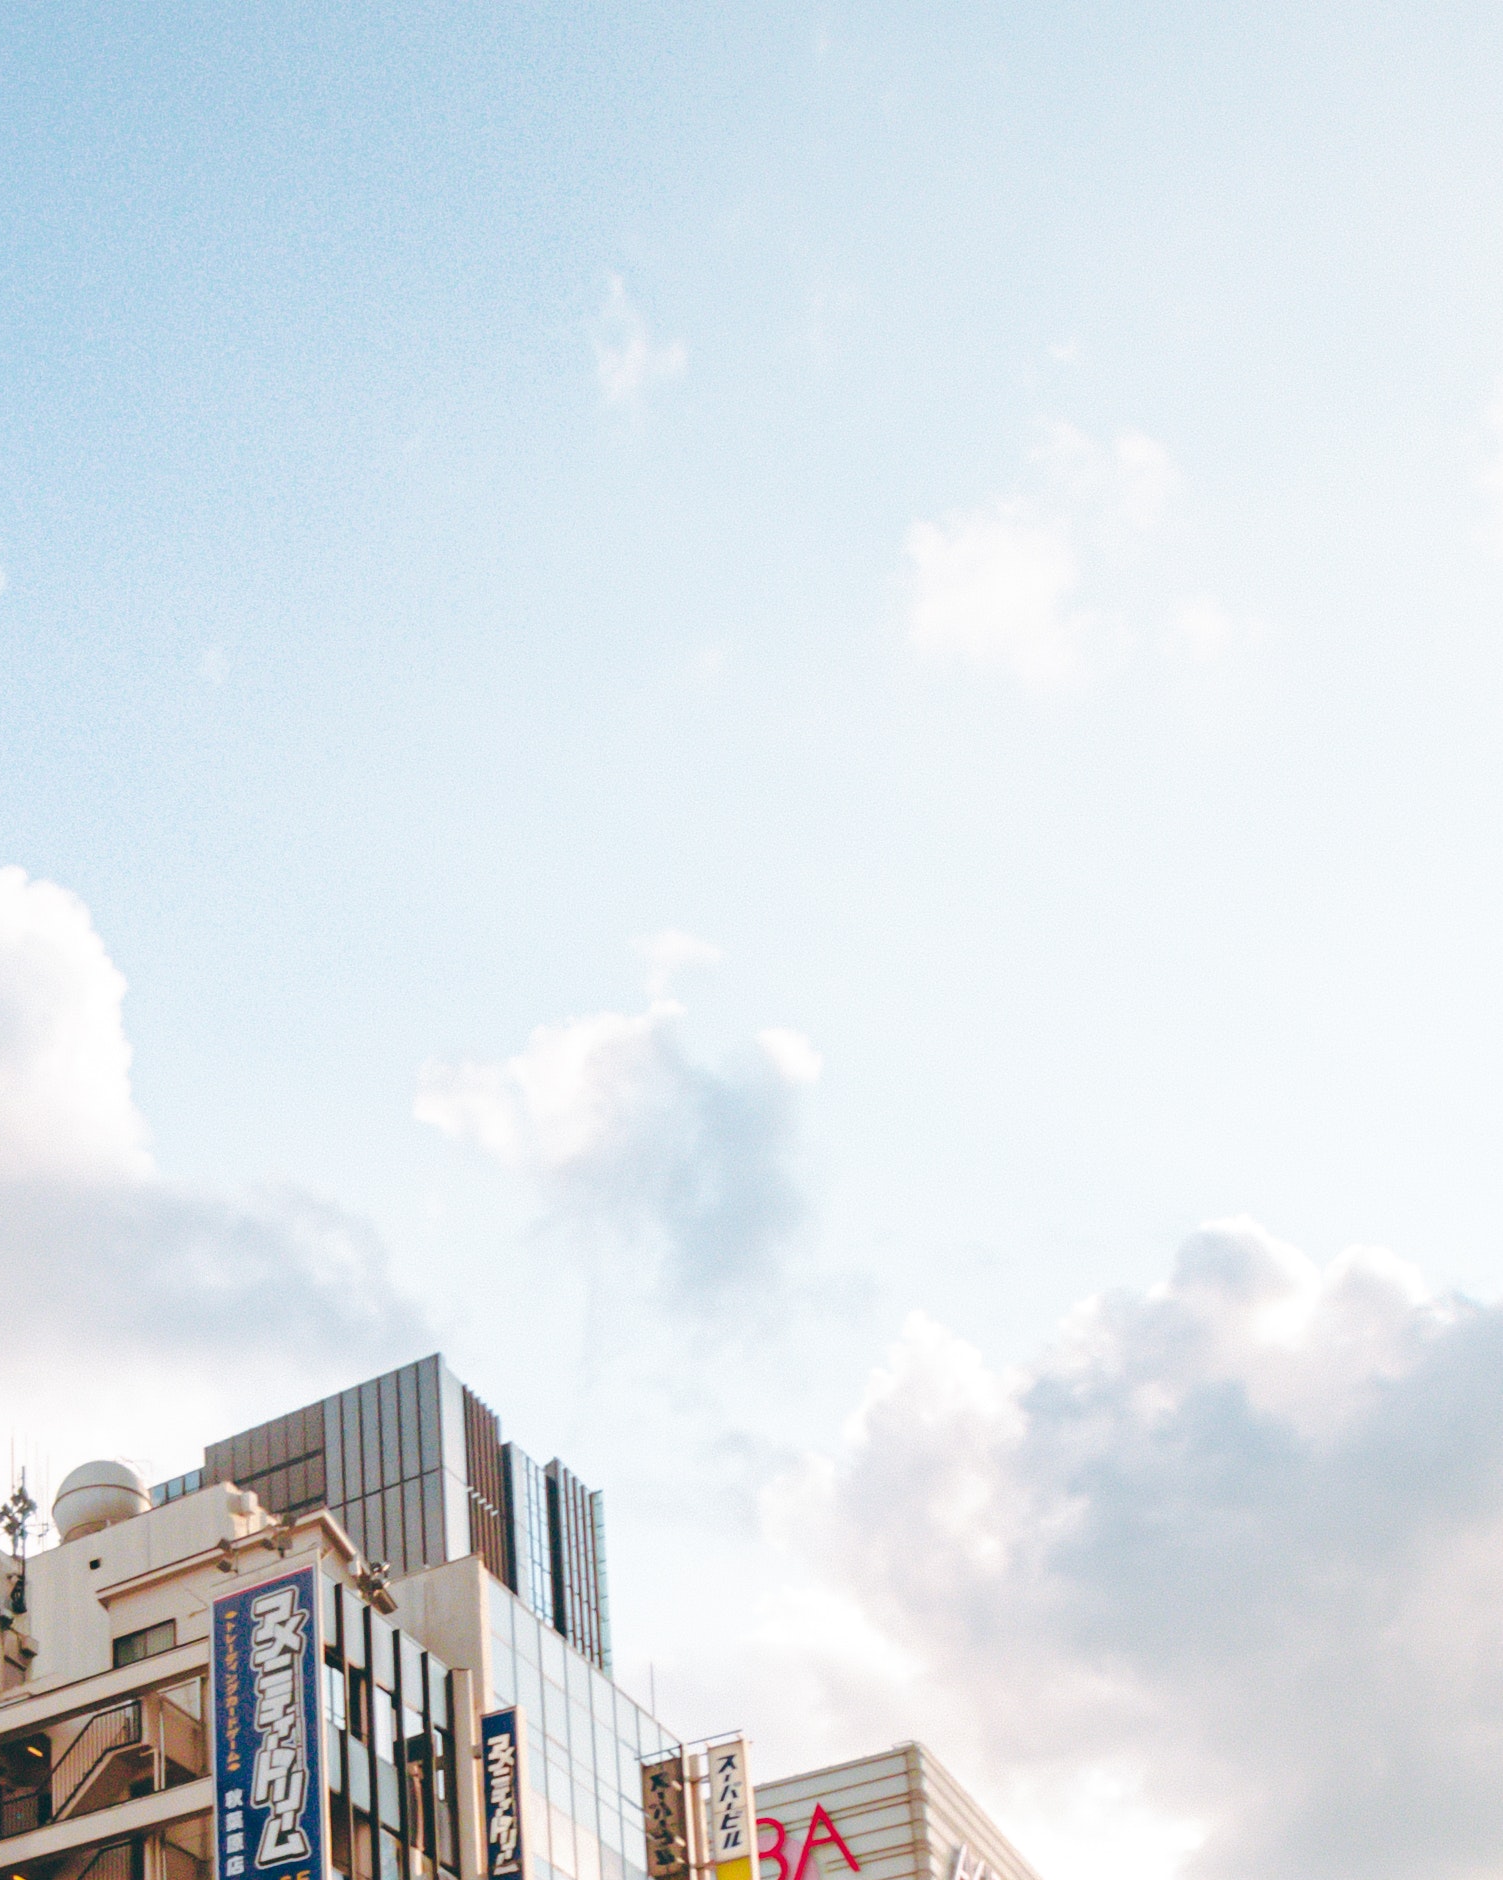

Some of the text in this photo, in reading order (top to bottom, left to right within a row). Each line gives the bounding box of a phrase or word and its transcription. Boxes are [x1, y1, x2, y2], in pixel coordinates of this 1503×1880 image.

[718, 1754, 743, 1850] スーパービル
